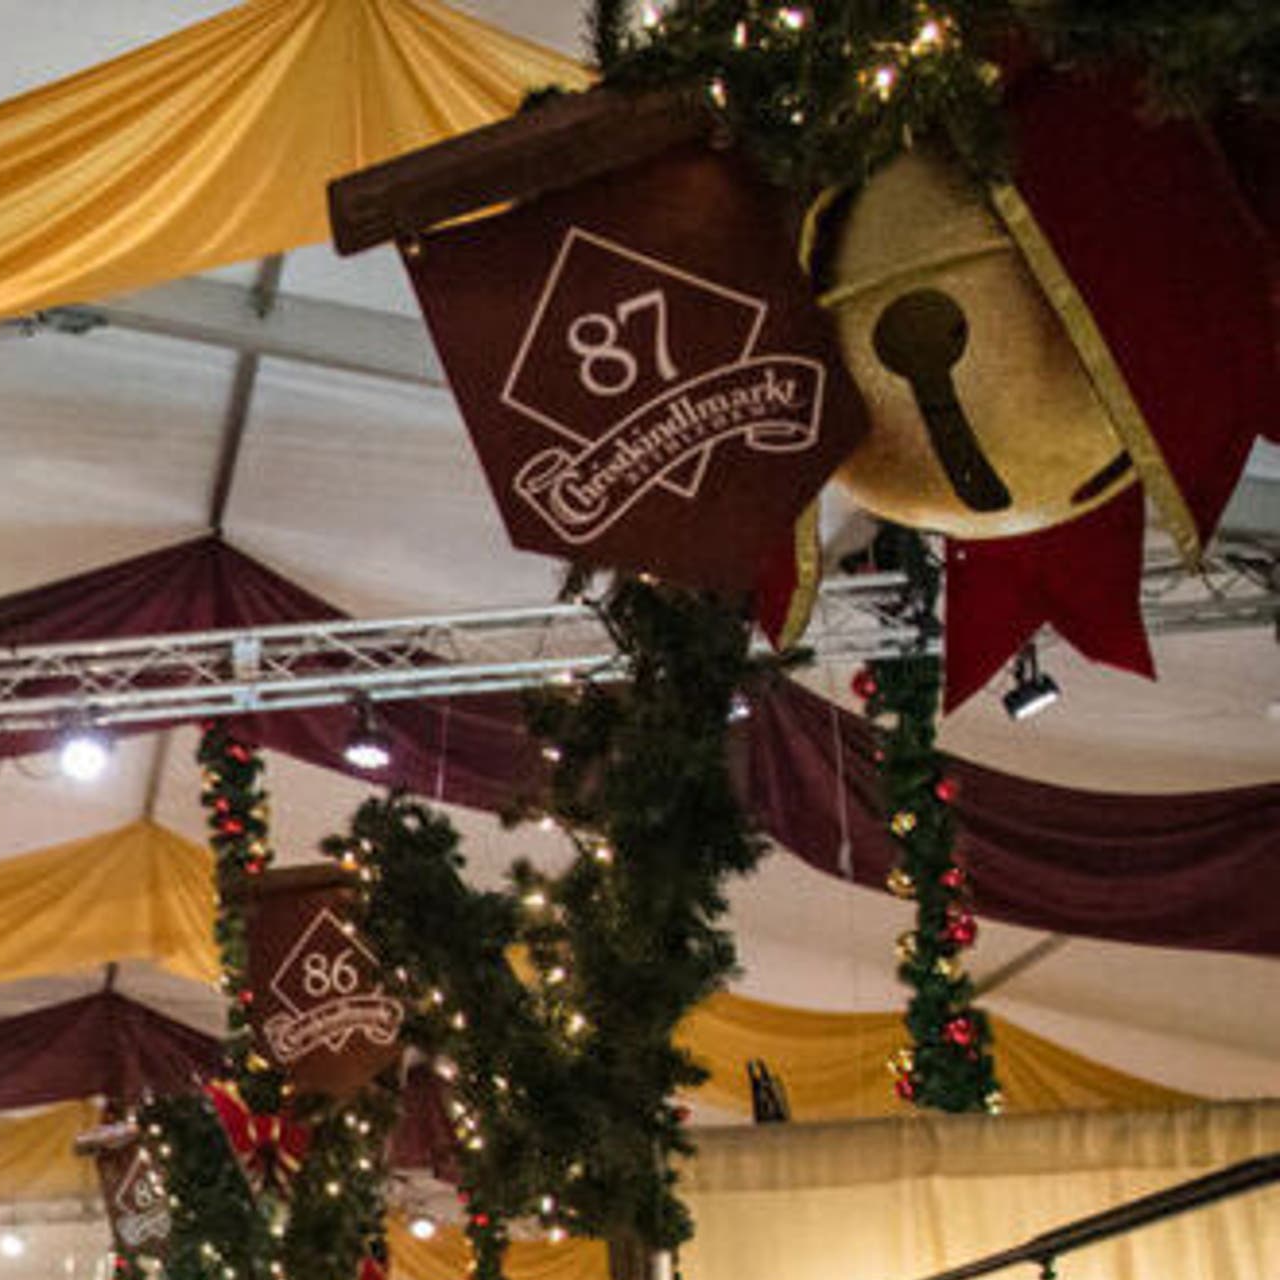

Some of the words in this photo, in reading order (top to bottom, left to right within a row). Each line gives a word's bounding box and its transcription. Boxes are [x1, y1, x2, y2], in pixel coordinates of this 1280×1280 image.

[567, 290, 678, 396] 87
[551, 369, 801, 526] Christkindlmarkt
[304, 948, 358, 997] 86
